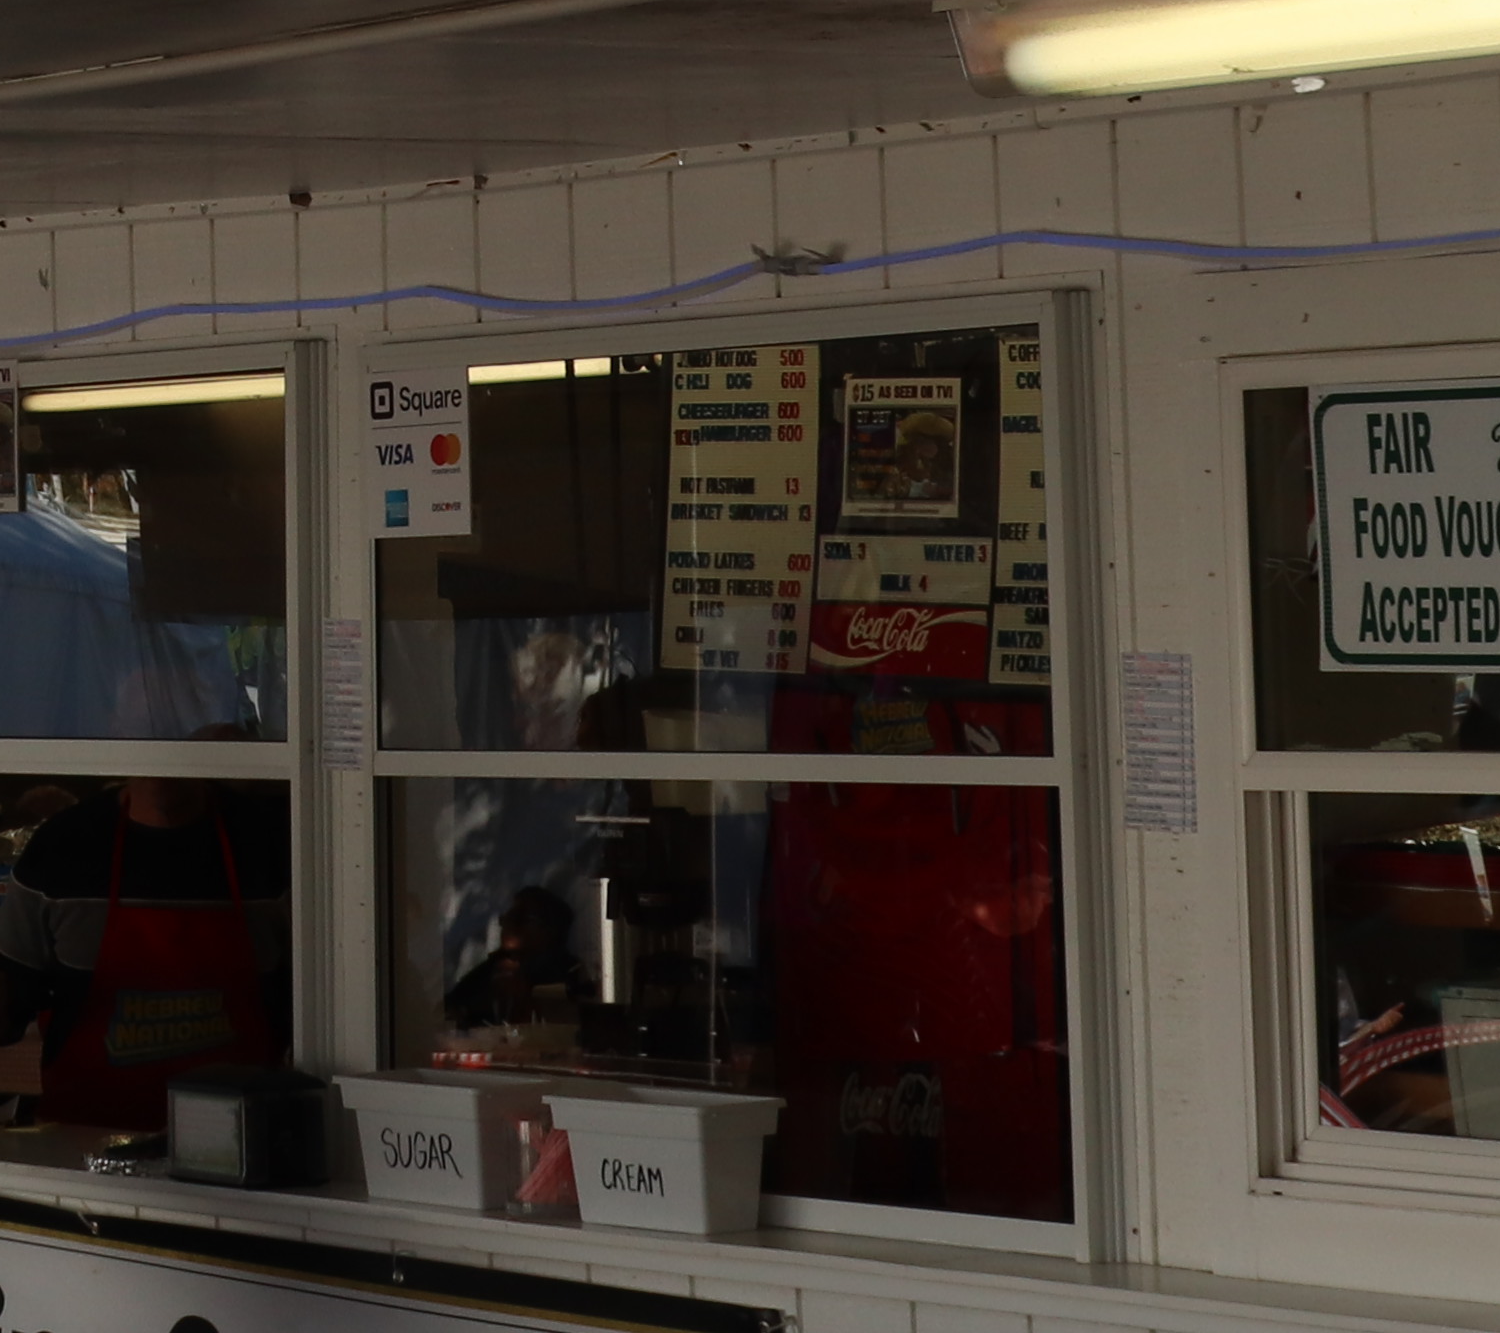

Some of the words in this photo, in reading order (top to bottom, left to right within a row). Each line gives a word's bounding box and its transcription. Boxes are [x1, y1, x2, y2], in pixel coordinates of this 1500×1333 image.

[779, 349, 804, 366] 500
[726, 373, 752, 389] DOG
[781, 371, 806, 389] 600
[399, 386, 462, 417] Square
[878, 385, 891, 399] AS
[894, 385, 918, 399] SEEN
[920, 385, 933, 399] ON
[936, 385, 953, 398] TV!
[777, 402, 800, 419] 600
[777, 424, 803, 442] 600
[1366, 411, 1436, 474] FAIR
[376, 443, 414, 466] VISA
[785, 477, 800, 495] 13
[1353, 497, 1428, 559] FOOD
[824, 541, 852, 560] SODA
[858, 542, 866, 559] 3
[924, 543, 974, 563] WATER
[978, 544, 987, 563] 3
[787, 553, 812, 571] 600
[880, 573, 911, 592] MILK
[919, 574, 928, 592] 4
[1359, 581, 1500, 644] ACCEPTED
[380, 1126, 463, 1179] SUGAR
[600, 1157, 665, 1197] CREAM
